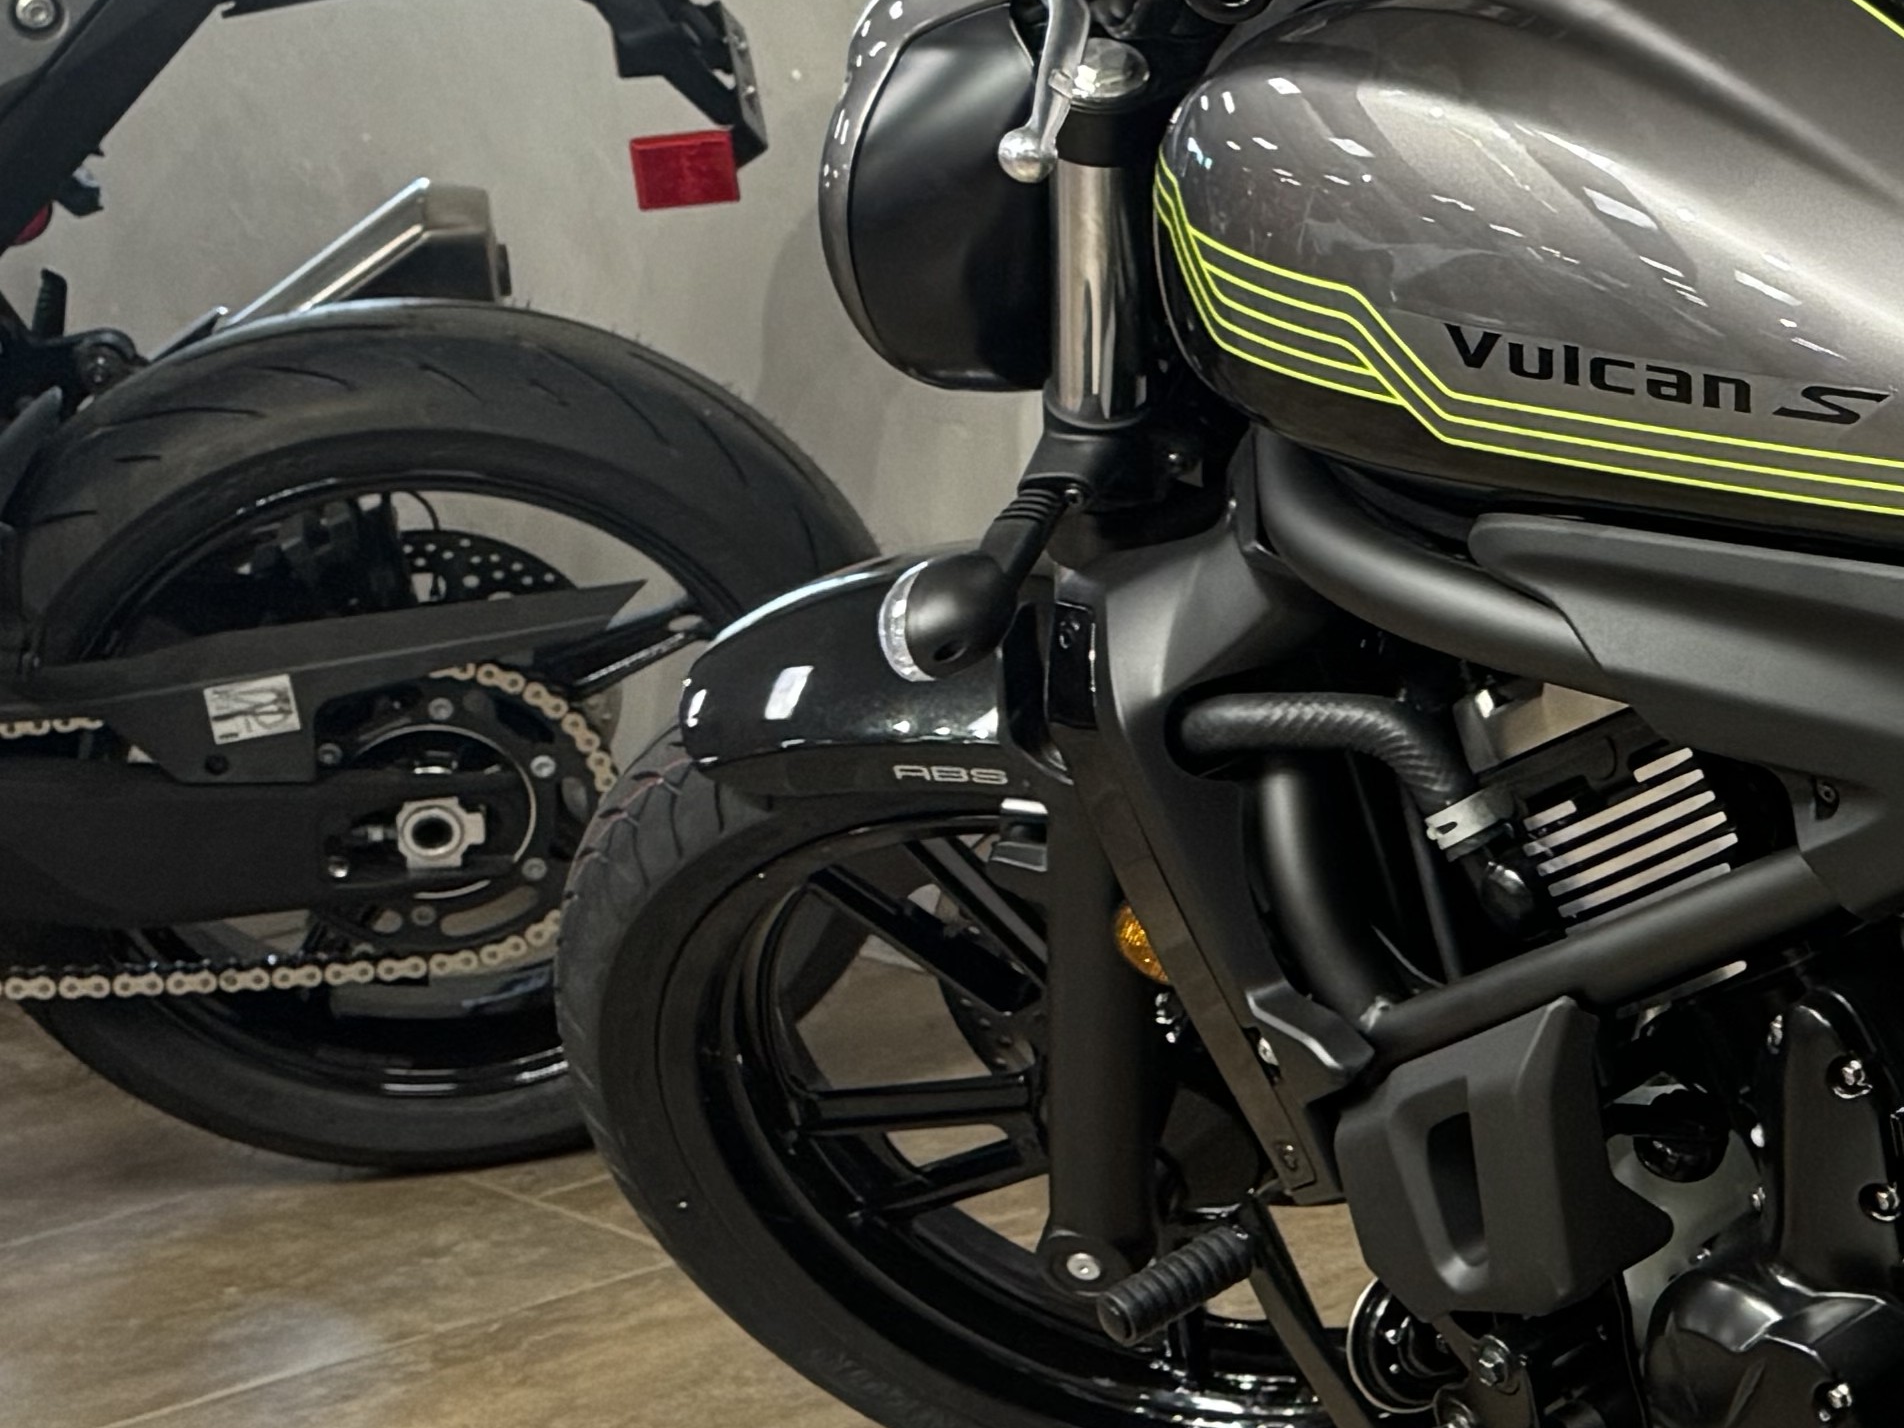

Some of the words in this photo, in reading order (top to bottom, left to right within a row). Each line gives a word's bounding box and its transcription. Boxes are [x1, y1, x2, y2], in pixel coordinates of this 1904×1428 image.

[1444, 323, 1752, 414] Vulcan
[1772, 385, 1890, 425] S
[893, 765, 1009, 785] ABS
